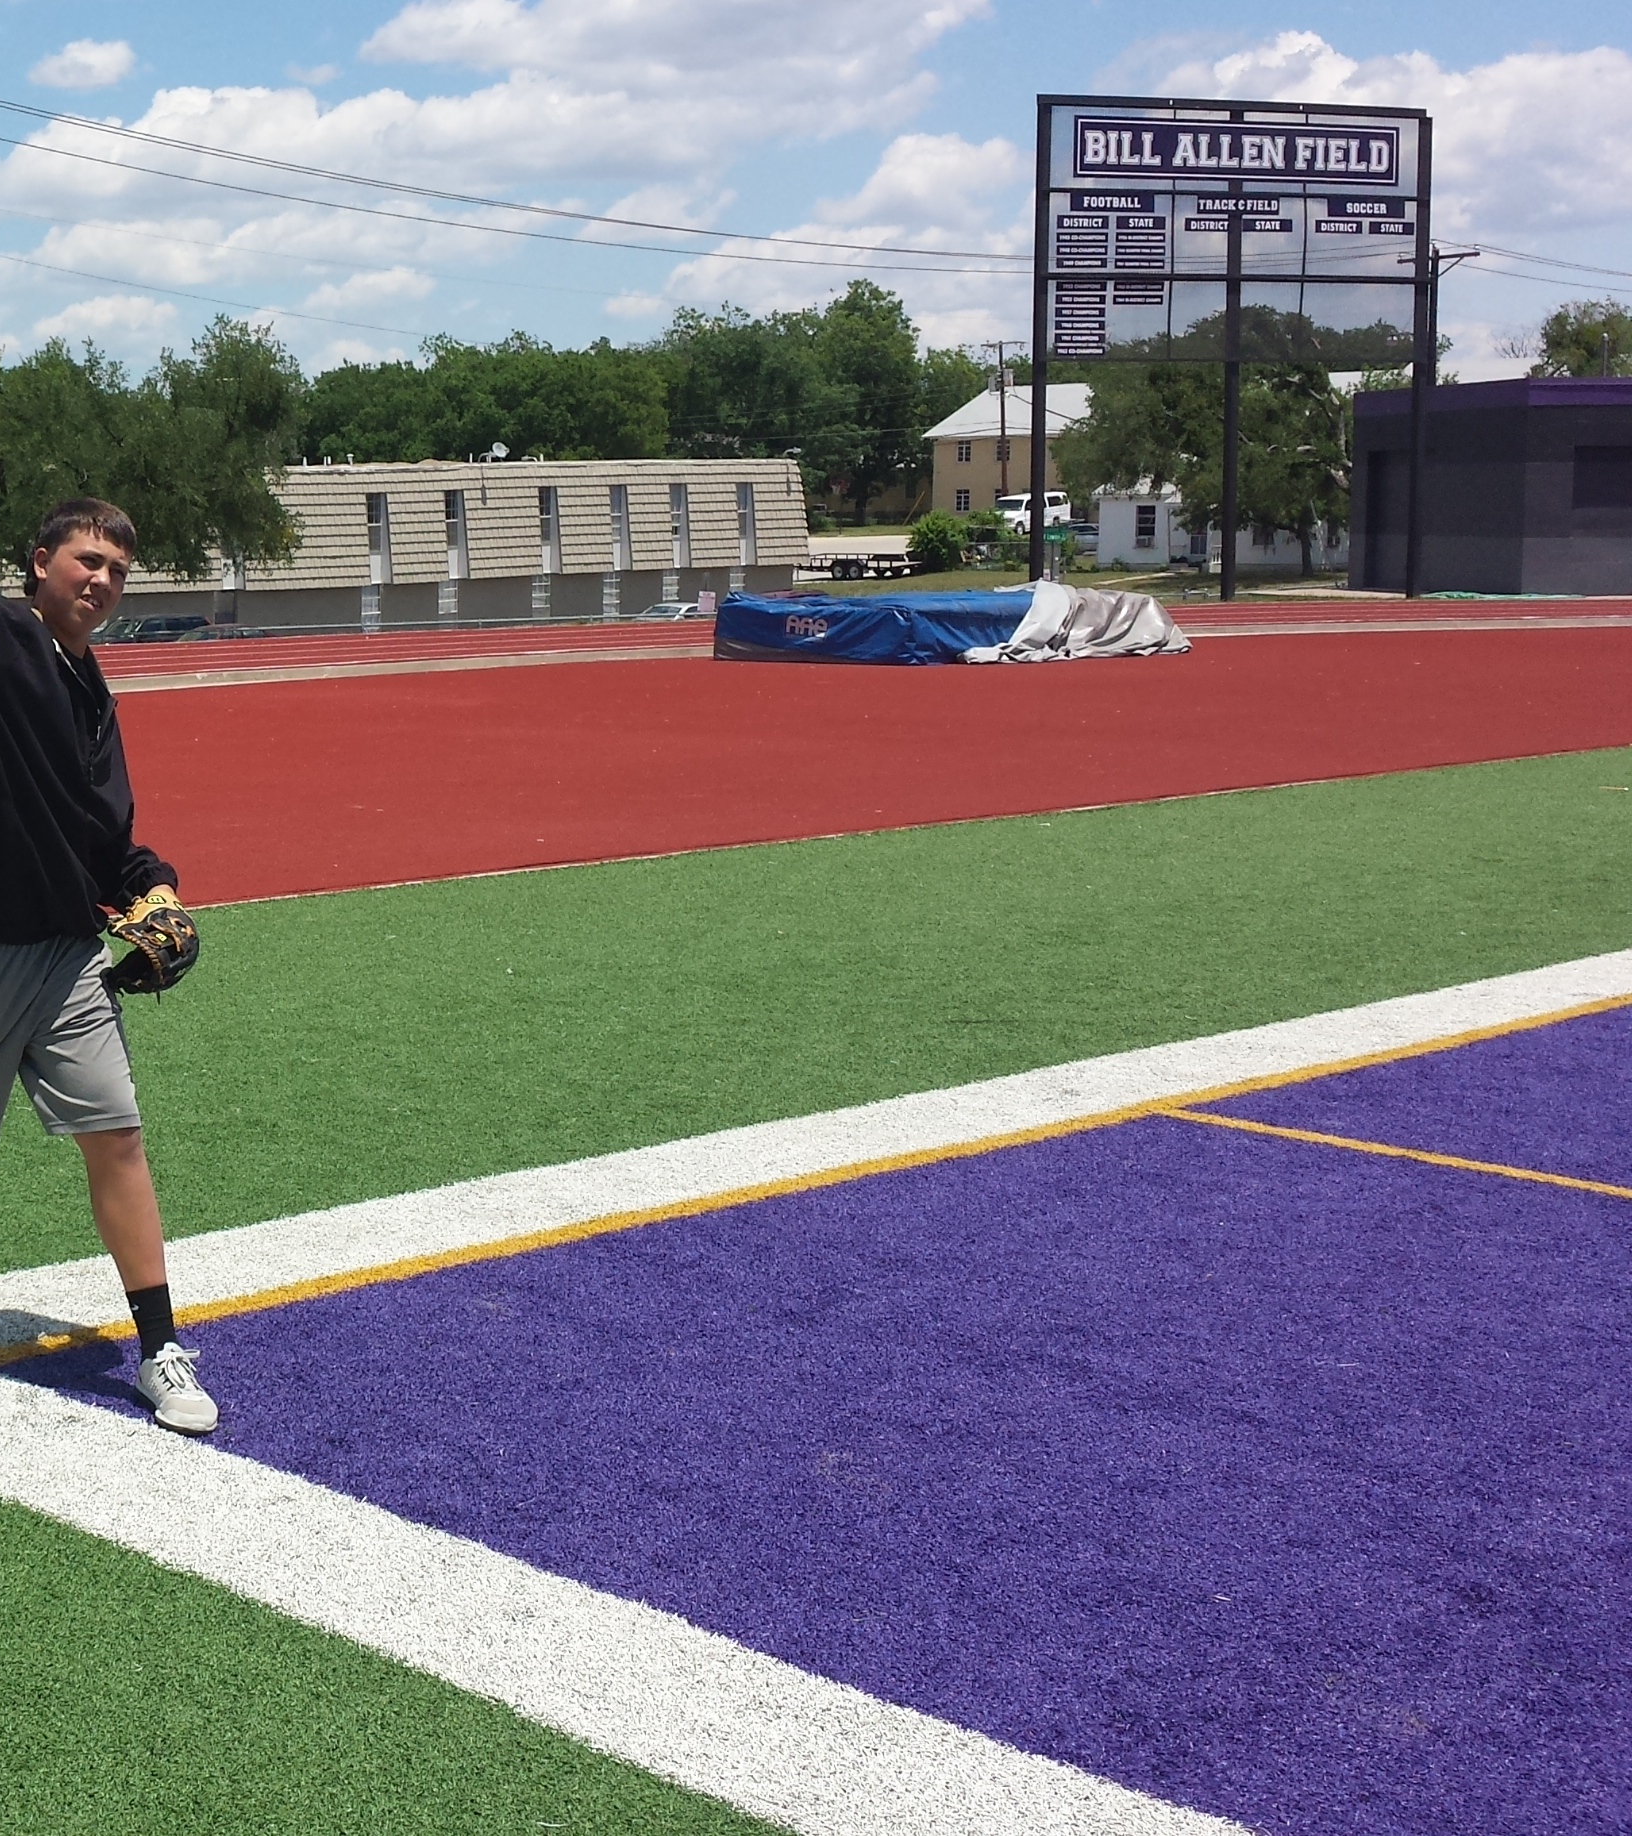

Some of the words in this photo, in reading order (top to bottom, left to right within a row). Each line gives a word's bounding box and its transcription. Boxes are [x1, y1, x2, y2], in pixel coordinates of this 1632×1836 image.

[1083, 130, 1161, 166] BILL
[1172, 133, 1286, 170] ALLEN
[1295, 137, 1390, 174] FIELD
[1083, 196, 1141, 209] FOOTBALL
[1198, 199, 1236, 211] TRACK
[1247, 200, 1279, 212] FIELD
[1346, 202, 1388, 215] SOCCER
[1063, 218, 1103, 228] DISTRICT
[1128, 218, 1154, 228] STATE
[1190, 221, 1229, 231] DISTRICT
[1255, 221, 1281, 231] STATE
[1321, 222, 1358, 232] DISTRICT
[1380, 223, 1404, 233] STATE
